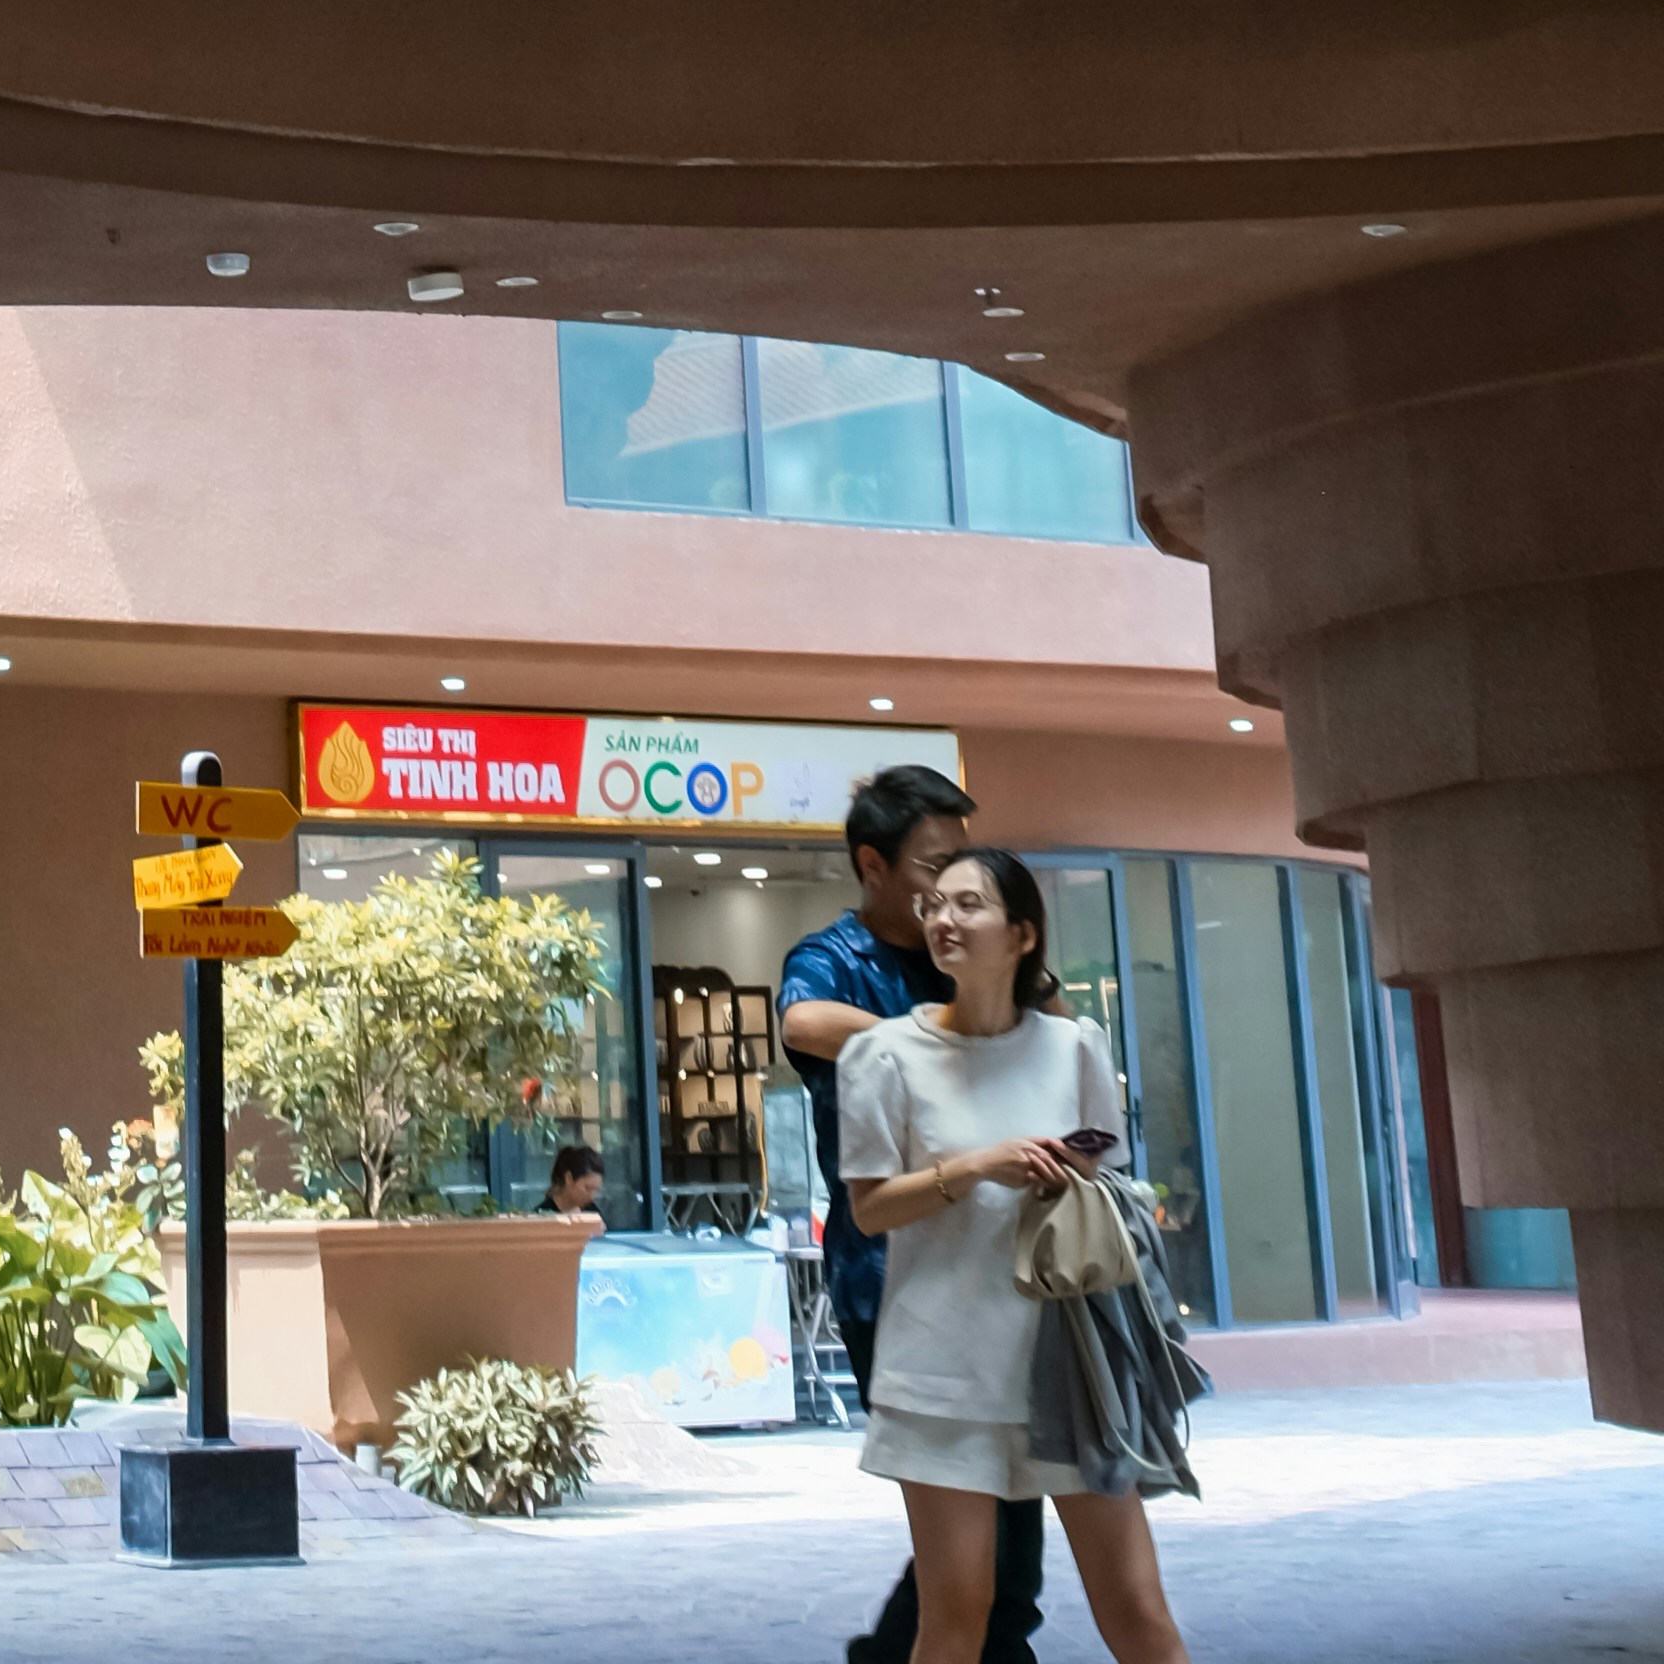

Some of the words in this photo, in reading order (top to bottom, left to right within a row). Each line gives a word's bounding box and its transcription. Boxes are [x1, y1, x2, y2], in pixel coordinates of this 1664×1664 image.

[382, 722, 433, 752] SIÊU
[437, 727, 476, 758] THỊ
[605, 729, 641, 752] SẢN
[646, 731, 699, 754] PHẨM
[382, 758, 479, 801] TINH
[487, 761, 566, 803] HOA
[598, 758, 765, 817] OCOP
[161, 794, 232, 833] WC
